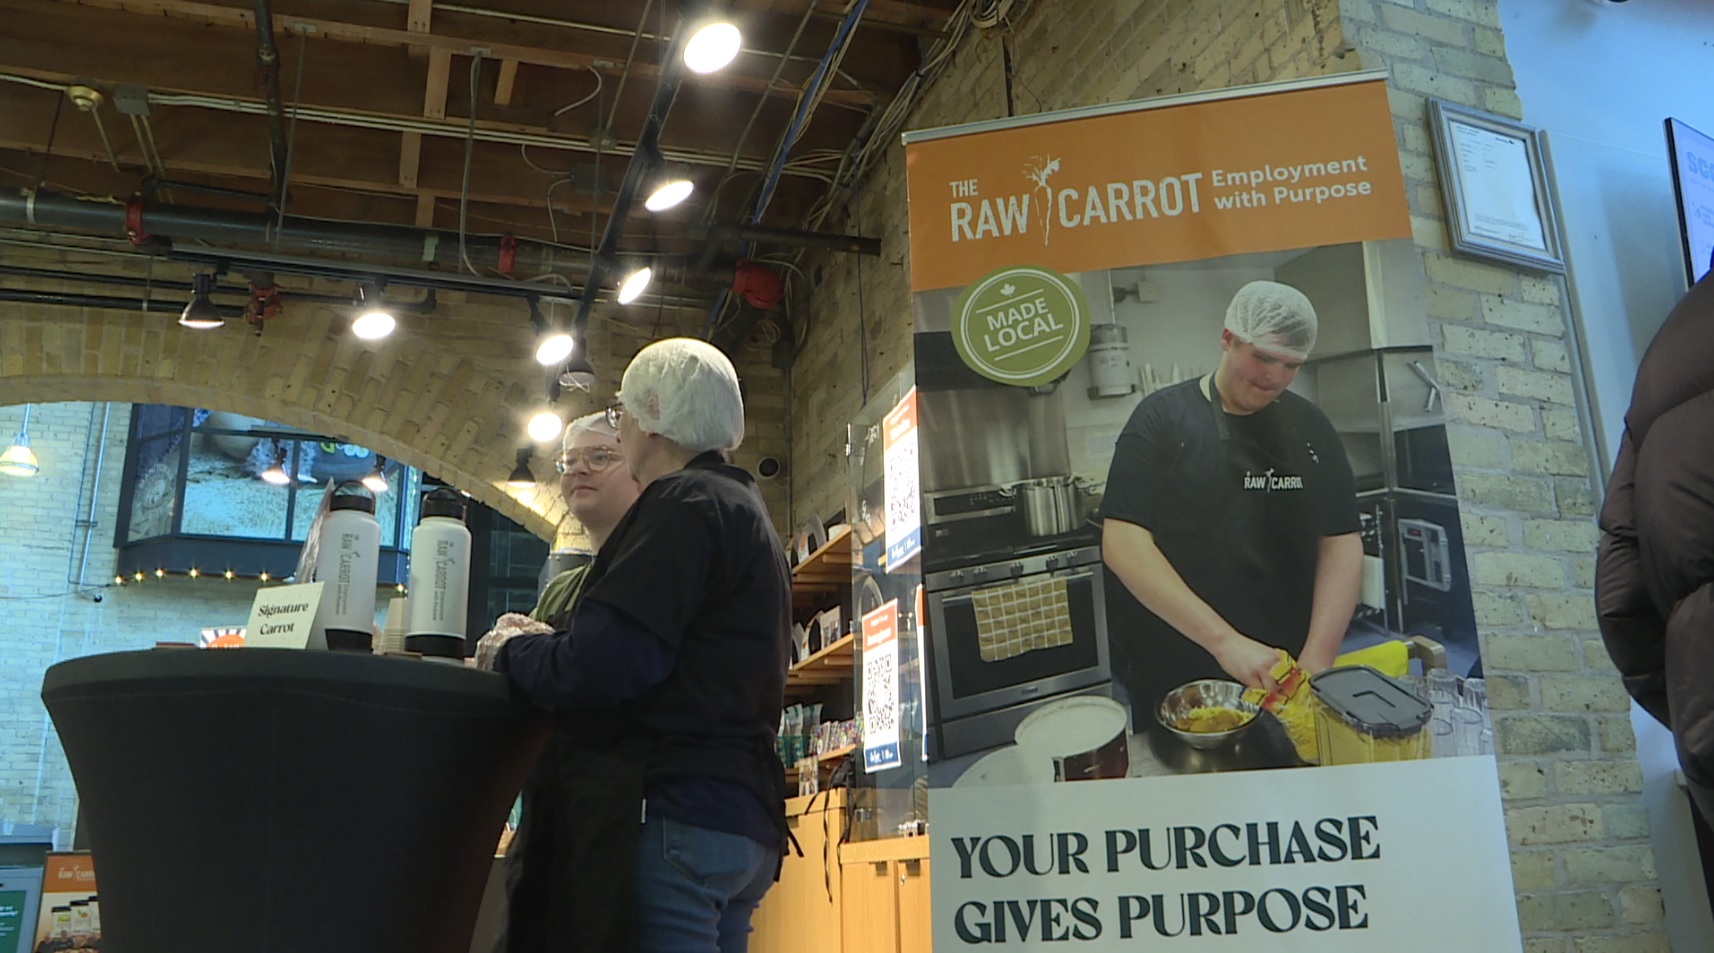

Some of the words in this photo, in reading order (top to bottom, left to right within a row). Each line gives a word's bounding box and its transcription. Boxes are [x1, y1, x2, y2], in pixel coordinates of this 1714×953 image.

[1211, 155, 1368, 188] Employment
[949, 179, 979, 198] THE
[1214, 189, 1266, 210] with
[1273, 181, 1372, 204] Purpose
[950, 193, 1030, 242] RAW
[1058, 171, 1203, 228] CARROT
[986, 297, 1049, 331] MADE
[983, 313, 1064, 352] LOCAL
[1244, 476, 1266, 489] RAW
[258, 602, 309, 618] Signature
[260, 622, 295, 635] Carrot
[950, 832, 1090, 879] YOUR
[1104, 815, 1381, 873] PURCHASE
[954, 896, 1103, 944] GIVES
[1117, 884, 1369, 939] PURPOSE
